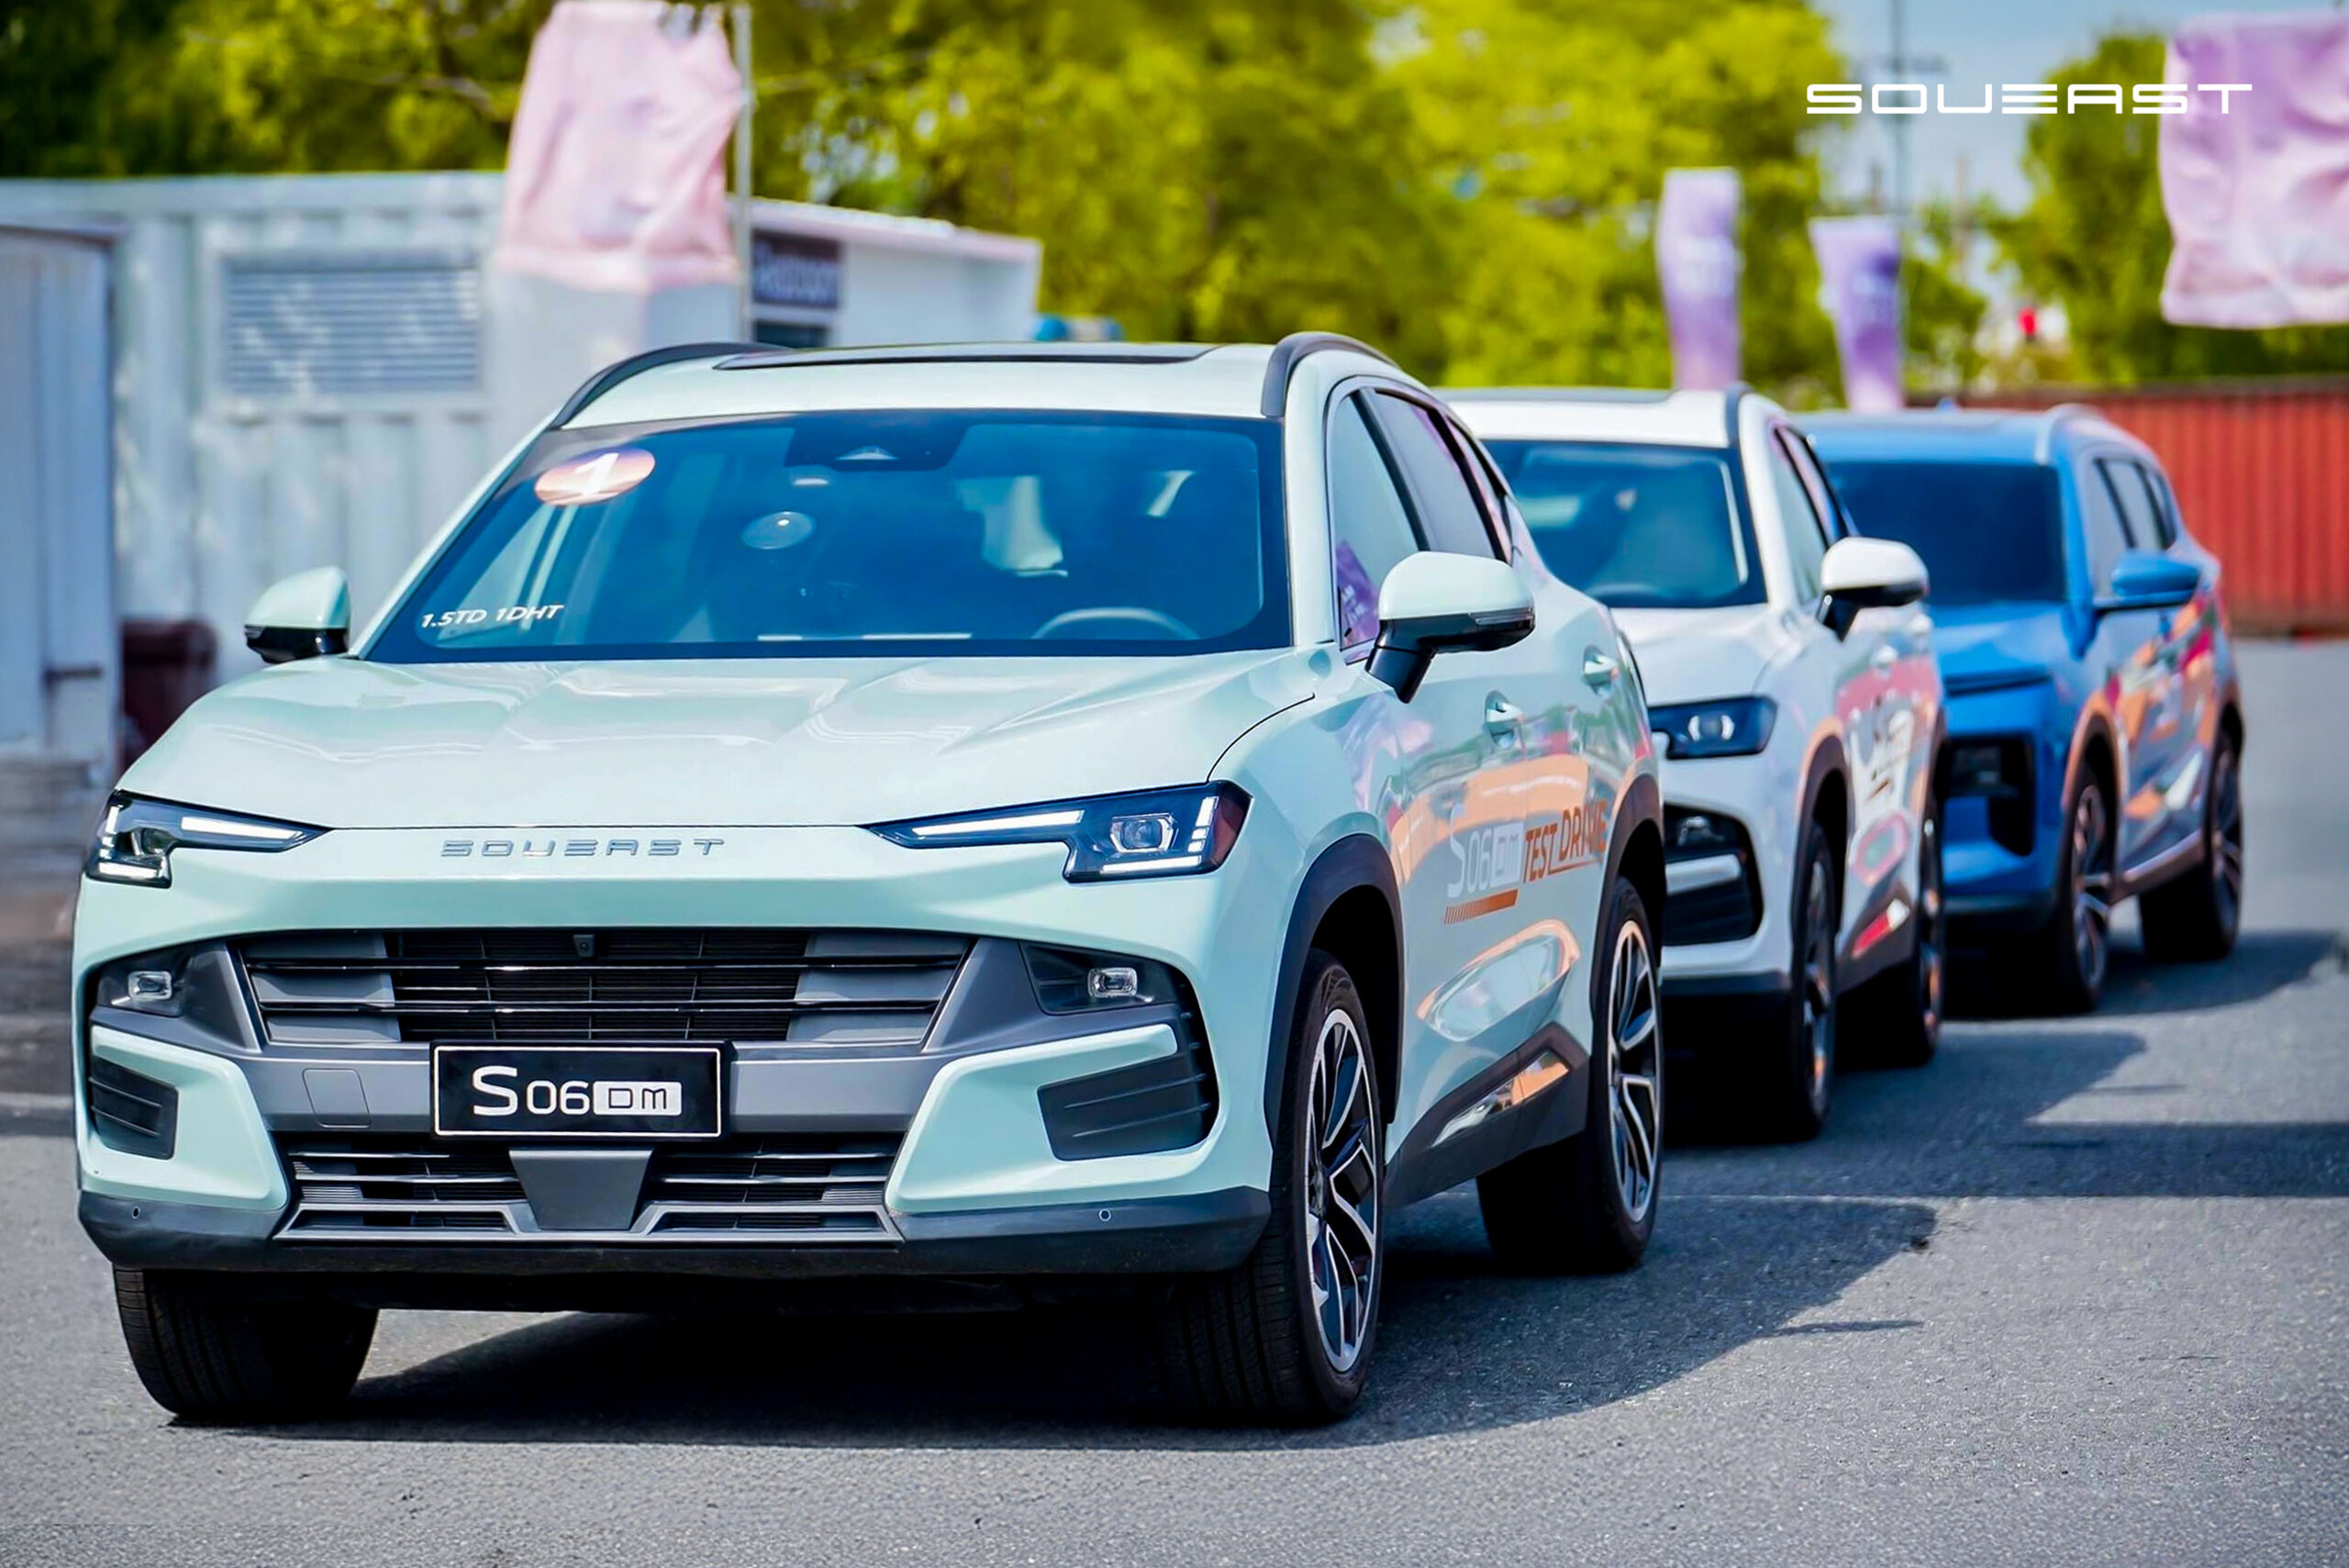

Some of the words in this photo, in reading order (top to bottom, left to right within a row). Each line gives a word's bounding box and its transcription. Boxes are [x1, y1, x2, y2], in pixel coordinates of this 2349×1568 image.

[574, 452, 619, 496] 1
[420, 608, 487, 628] 1.5TD
[496, 605, 564, 622] 1DHT
[441, 839, 725, 857] SOUEAST
[1523, 821, 1558, 884] TEST
[1558, 799, 1608, 862] DRIVE
